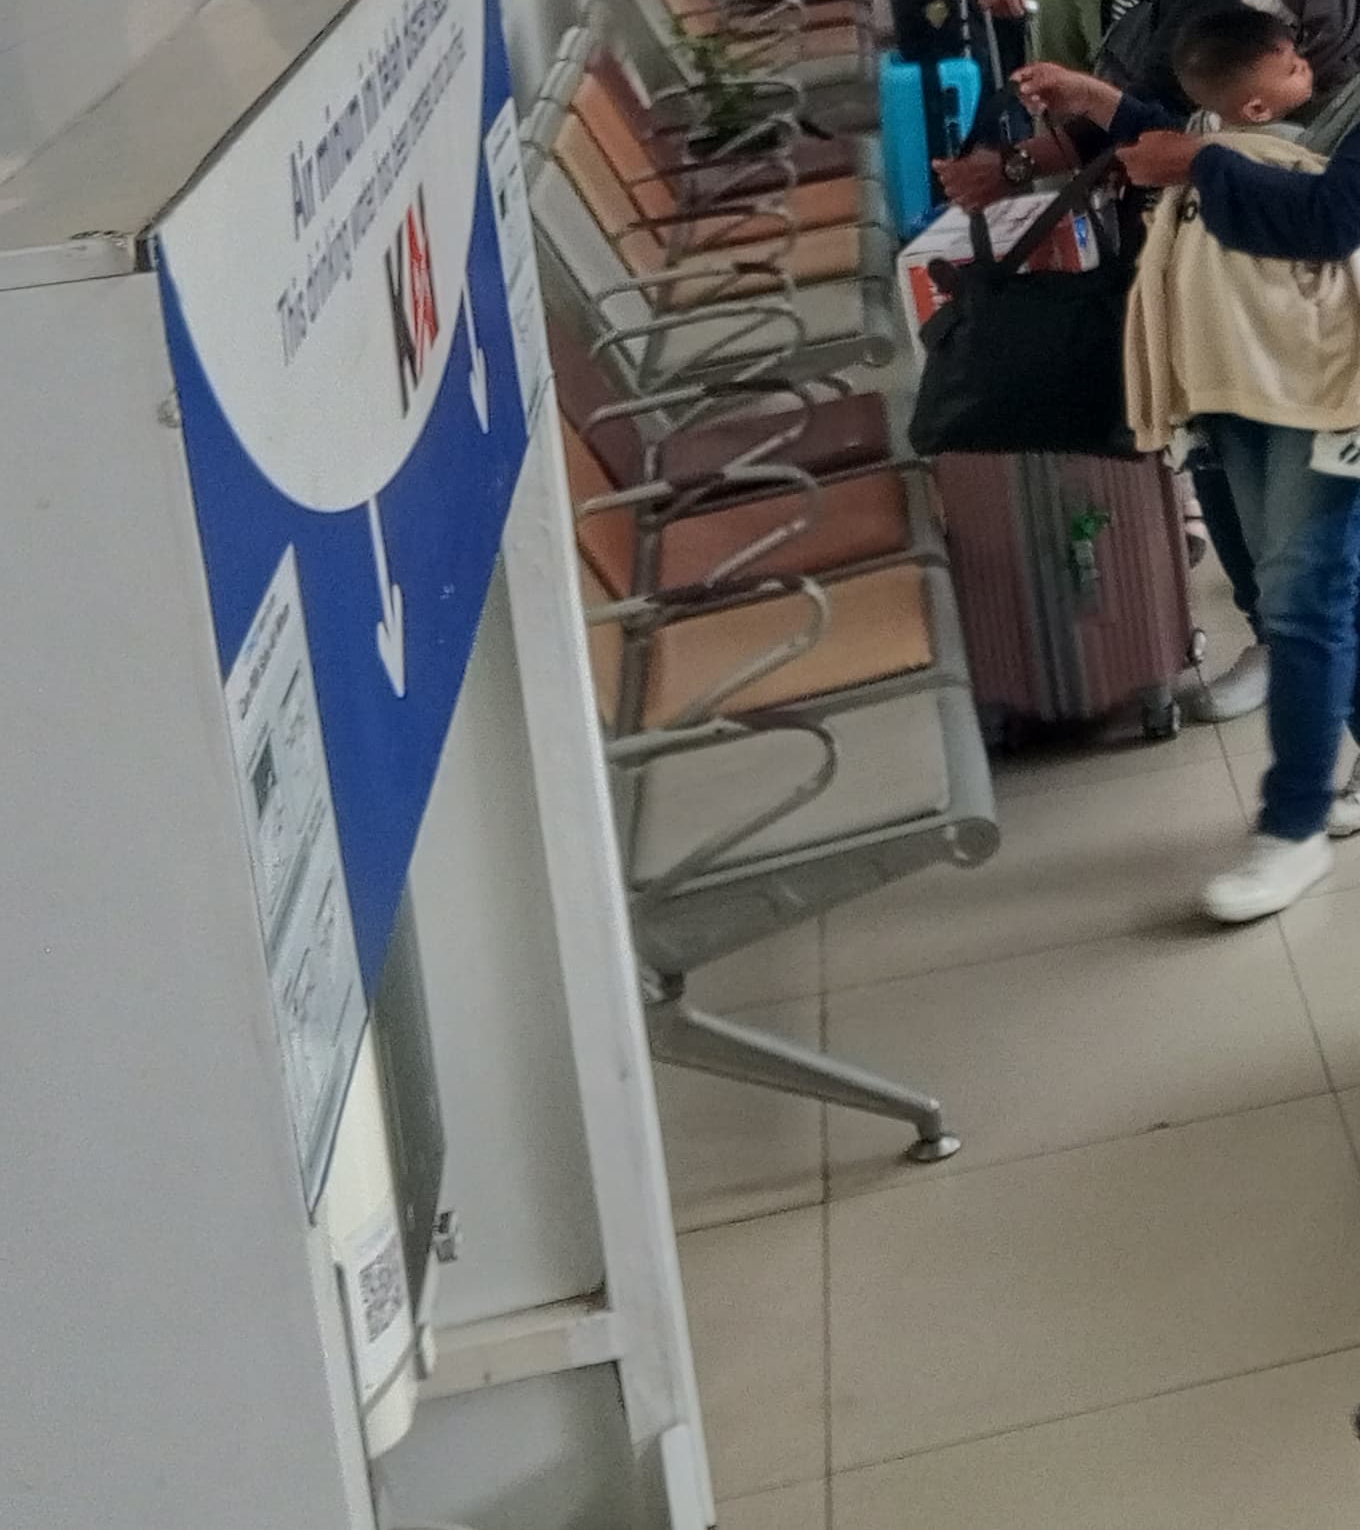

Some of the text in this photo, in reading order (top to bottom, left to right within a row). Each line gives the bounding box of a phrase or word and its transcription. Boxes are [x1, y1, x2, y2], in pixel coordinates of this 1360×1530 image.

[290, 139, 316, 240] Air
[315, 102, 365, 203] minum
[277, 277, 307, 367] This
[384, 180, 440, 420] KAI
